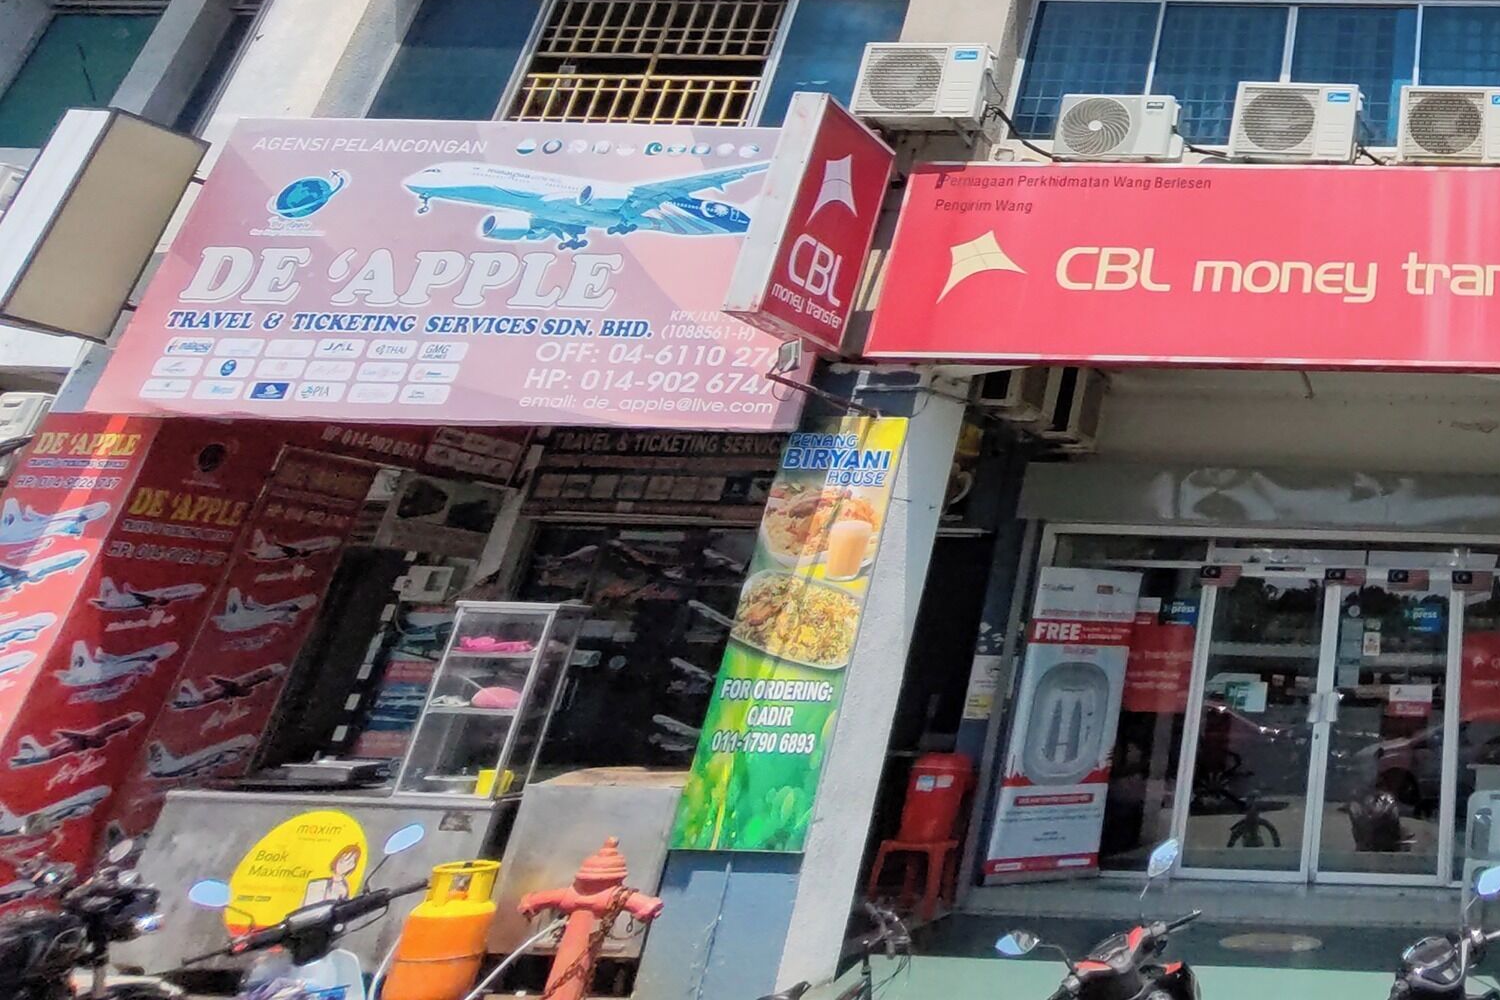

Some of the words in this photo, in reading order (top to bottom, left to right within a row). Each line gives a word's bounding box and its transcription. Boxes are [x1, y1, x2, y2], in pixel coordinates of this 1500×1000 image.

[251, 136, 331, 151] AGENSI
[331, 137, 488, 154] PELANCONGAN
[1017, 175, 1109, 188] Perkhidmatan
[1113, 176, 1151, 190] Wang
[1154, 176, 1212, 189] Berlesen
[934, 199, 991, 213] Pengirim
[995, 200, 1033, 214] Wang
[177, 245, 312, 306] DE
[788, 232, 843, 308] CBL
[1055, 246, 1171, 292] CBL
[1191, 259, 1378, 304] money
[771, 282, 805, 314] money
[805, 295, 842, 330] transfer
[165, 309, 254, 330] TRAVEL
[262, 311, 286, 331] &
[290, 311, 417, 333] TICKETING
[424, 315, 539, 335] SERVICES
[540, 317, 595, 337] SDN.
[597, 319, 655, 338] BHD.
[660, 323, 757, 341] (1088561-H)
[534, 341, 600, 364] OFF:
[608, 342, 727, 368] 04-6110
[524, 367, 572, 390] HP:
[579, 369, 699, 393] 014-902
[518, 396, 577, 410] email:
[583, 394, 773, 415] de_apple@live.com
[32, 431, 69, 454] DE
[552, 431, 612, 452] TRAVEL
[633, 433, 719, 454] TICKETING
[789, 431, 859, 449] PENANG
[782, 446, 893, 472] BIRYANI
[826, 469, 886, 486] HOUSE
[128, 486, 170, 517] DE
[1034, 621, 1082, 641] FREE
[720, 678, 750, 701] FOR
[751, 678, 834, 703] ORDERING:
[747, 704, 794, 728] QADIR
[711, 729, 777, 754] 011-1790
[779, 732, 815, 754] 6893
[296, 823, 342, 835] maxim
[255, 849, 289, 863] Book
[248, 865, 314, 879] MaximCar
